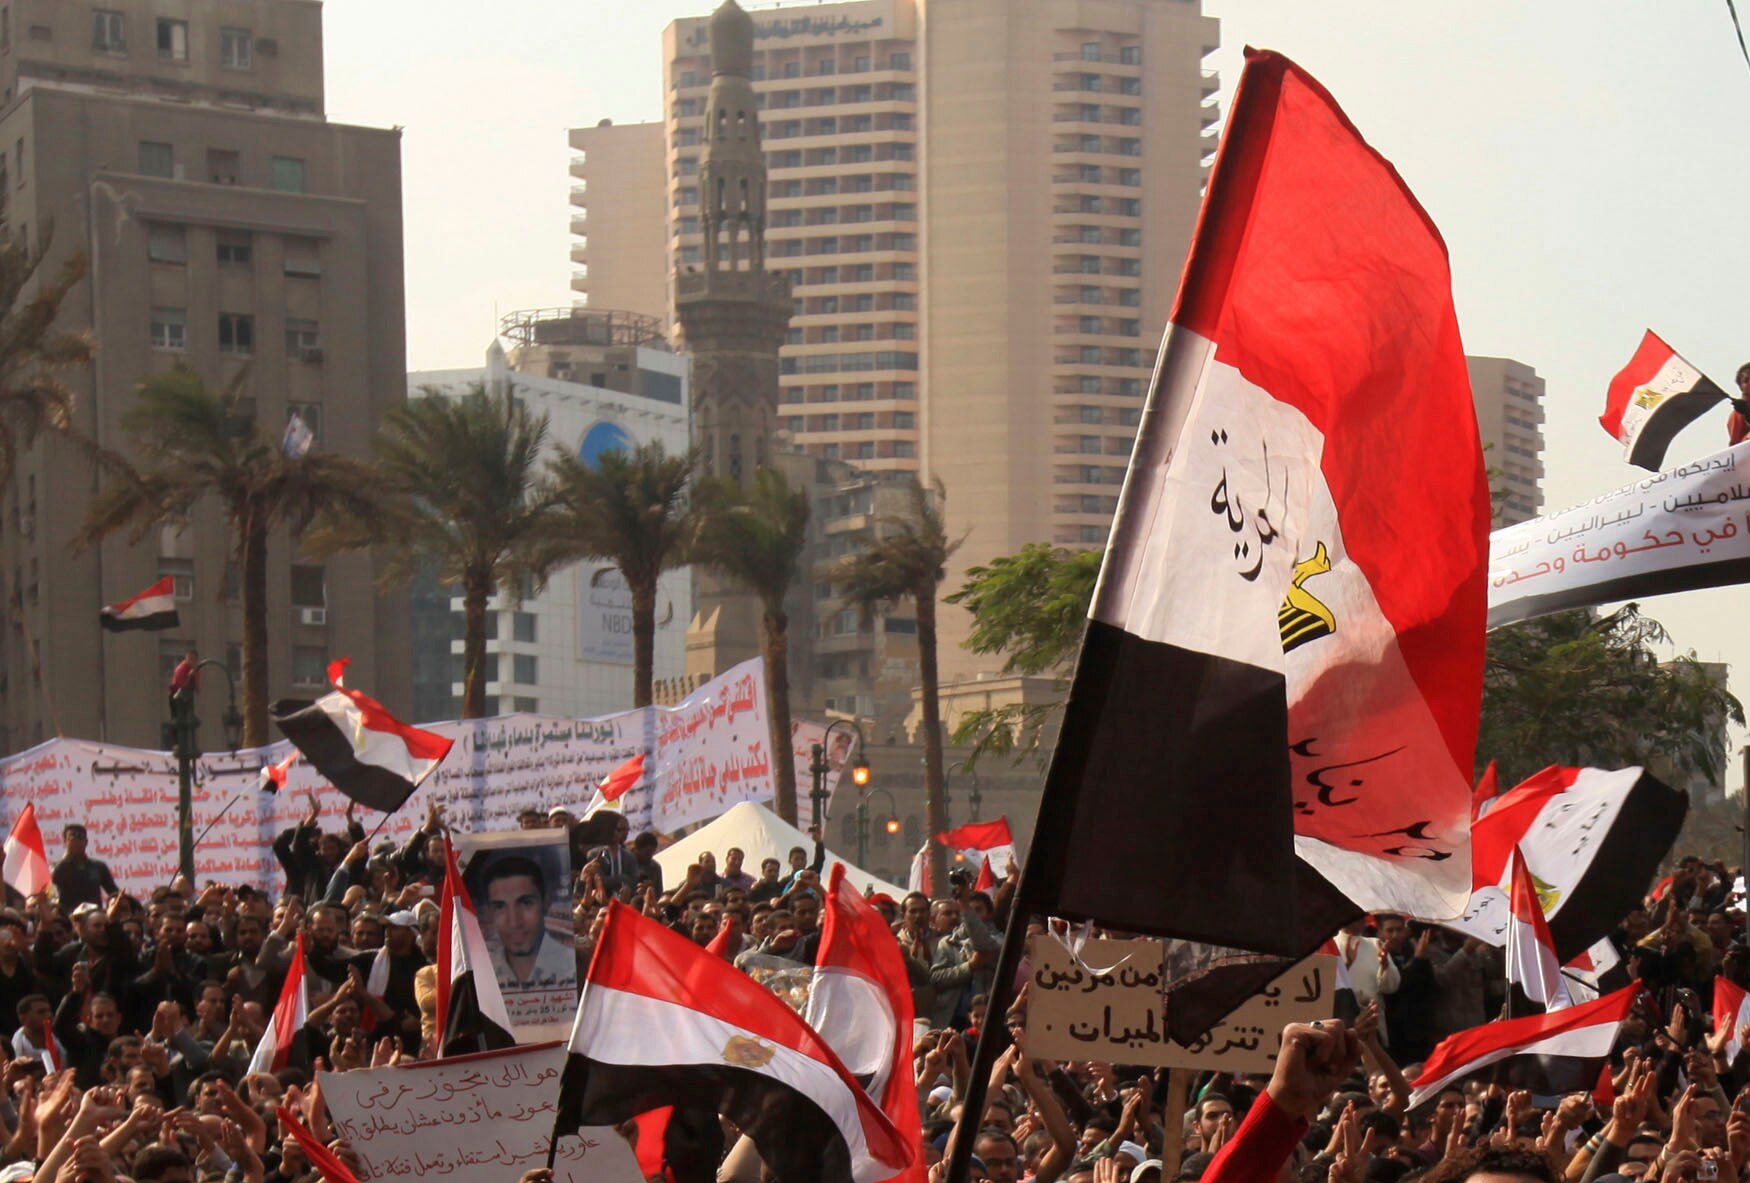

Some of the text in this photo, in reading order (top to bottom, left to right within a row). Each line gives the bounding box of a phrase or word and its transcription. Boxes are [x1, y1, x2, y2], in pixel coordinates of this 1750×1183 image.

[1572, 529, 1685, 563] حكومة
[1692, 516, 1738, 554] في
[1294, 967, 1322, 1002] لا
[524, 1067, 558, 1087] هو
[401, 1107, 441, 1136] عشان
